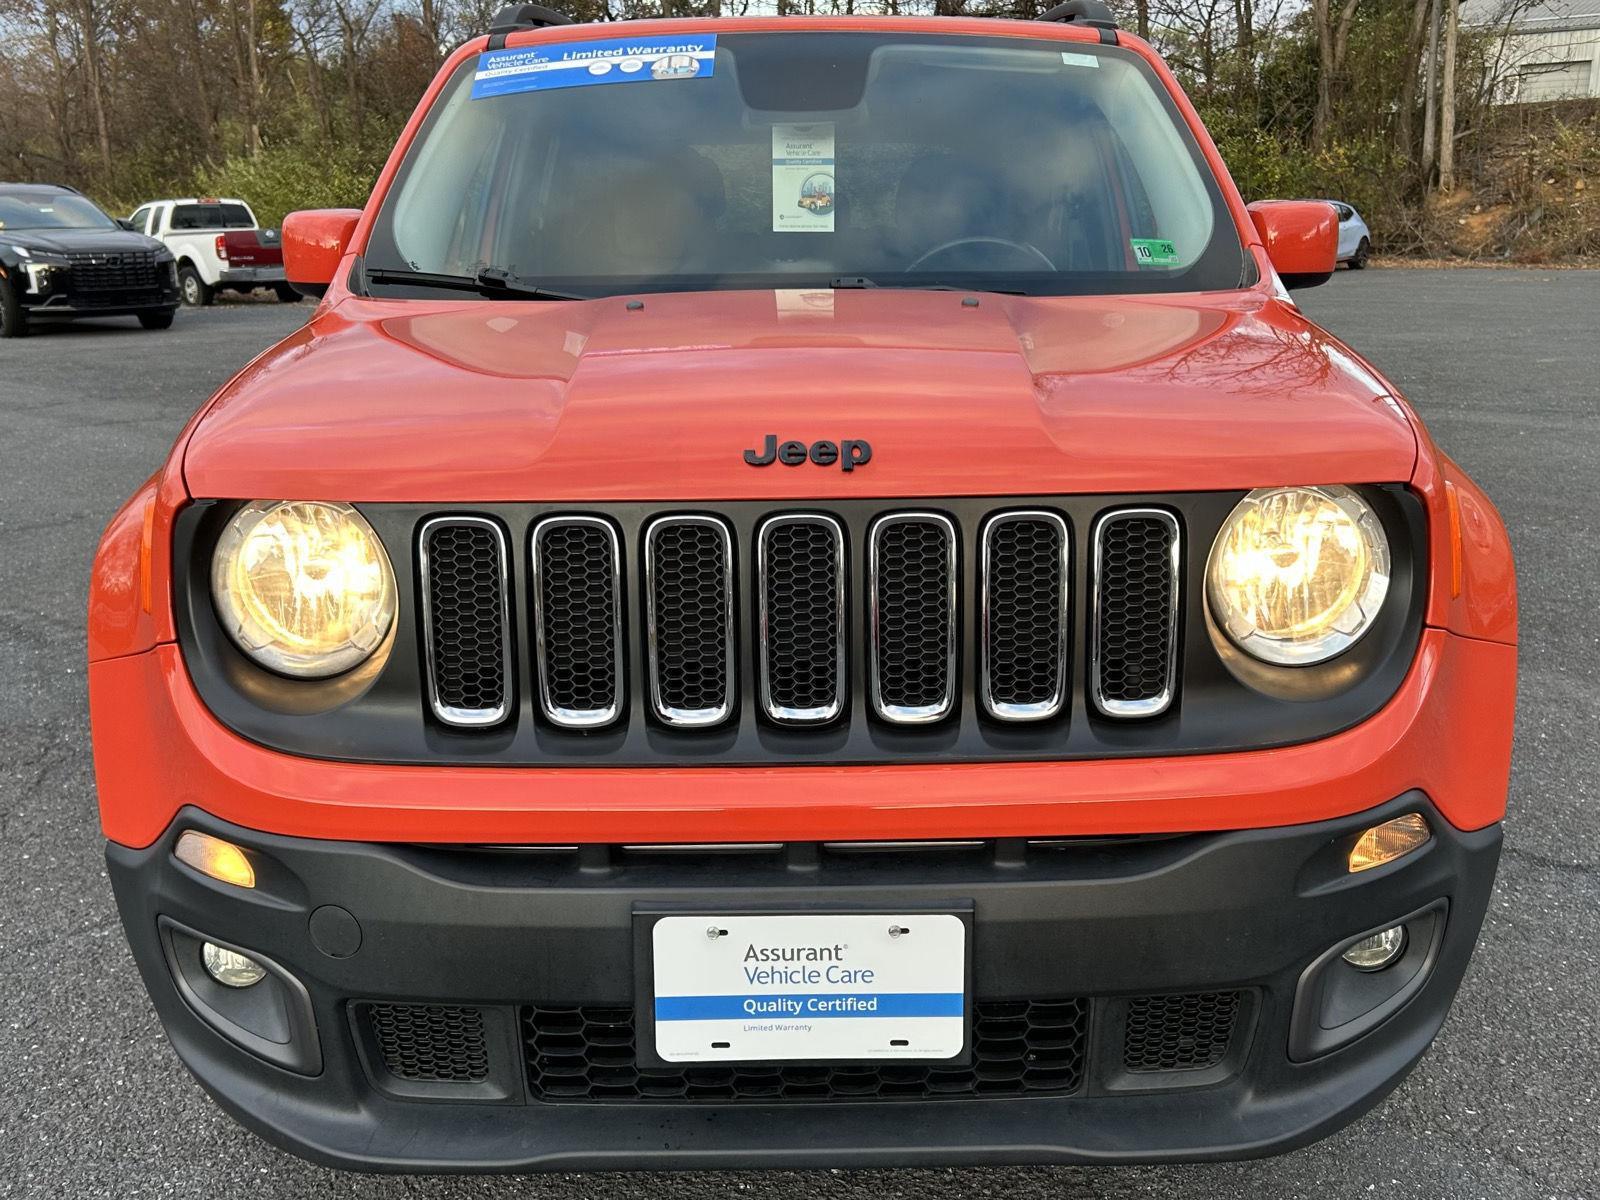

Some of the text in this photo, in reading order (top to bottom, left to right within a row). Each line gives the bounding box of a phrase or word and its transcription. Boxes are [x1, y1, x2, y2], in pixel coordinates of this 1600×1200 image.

[488, 52, 535, 63] Assurant
[563, 44, 704, 60] Limited Warranty
[487, 57, 549, 69] Vehicle Care
[1137, 246, 1151, 257] 10
[743, 434, 872, 472] Jeep
[744, 965, 875, 985] Vehicle Care
[743, 997, 878, 1015] Quality Certified
[743, 1023, 813, 1032] Limited Warranty
